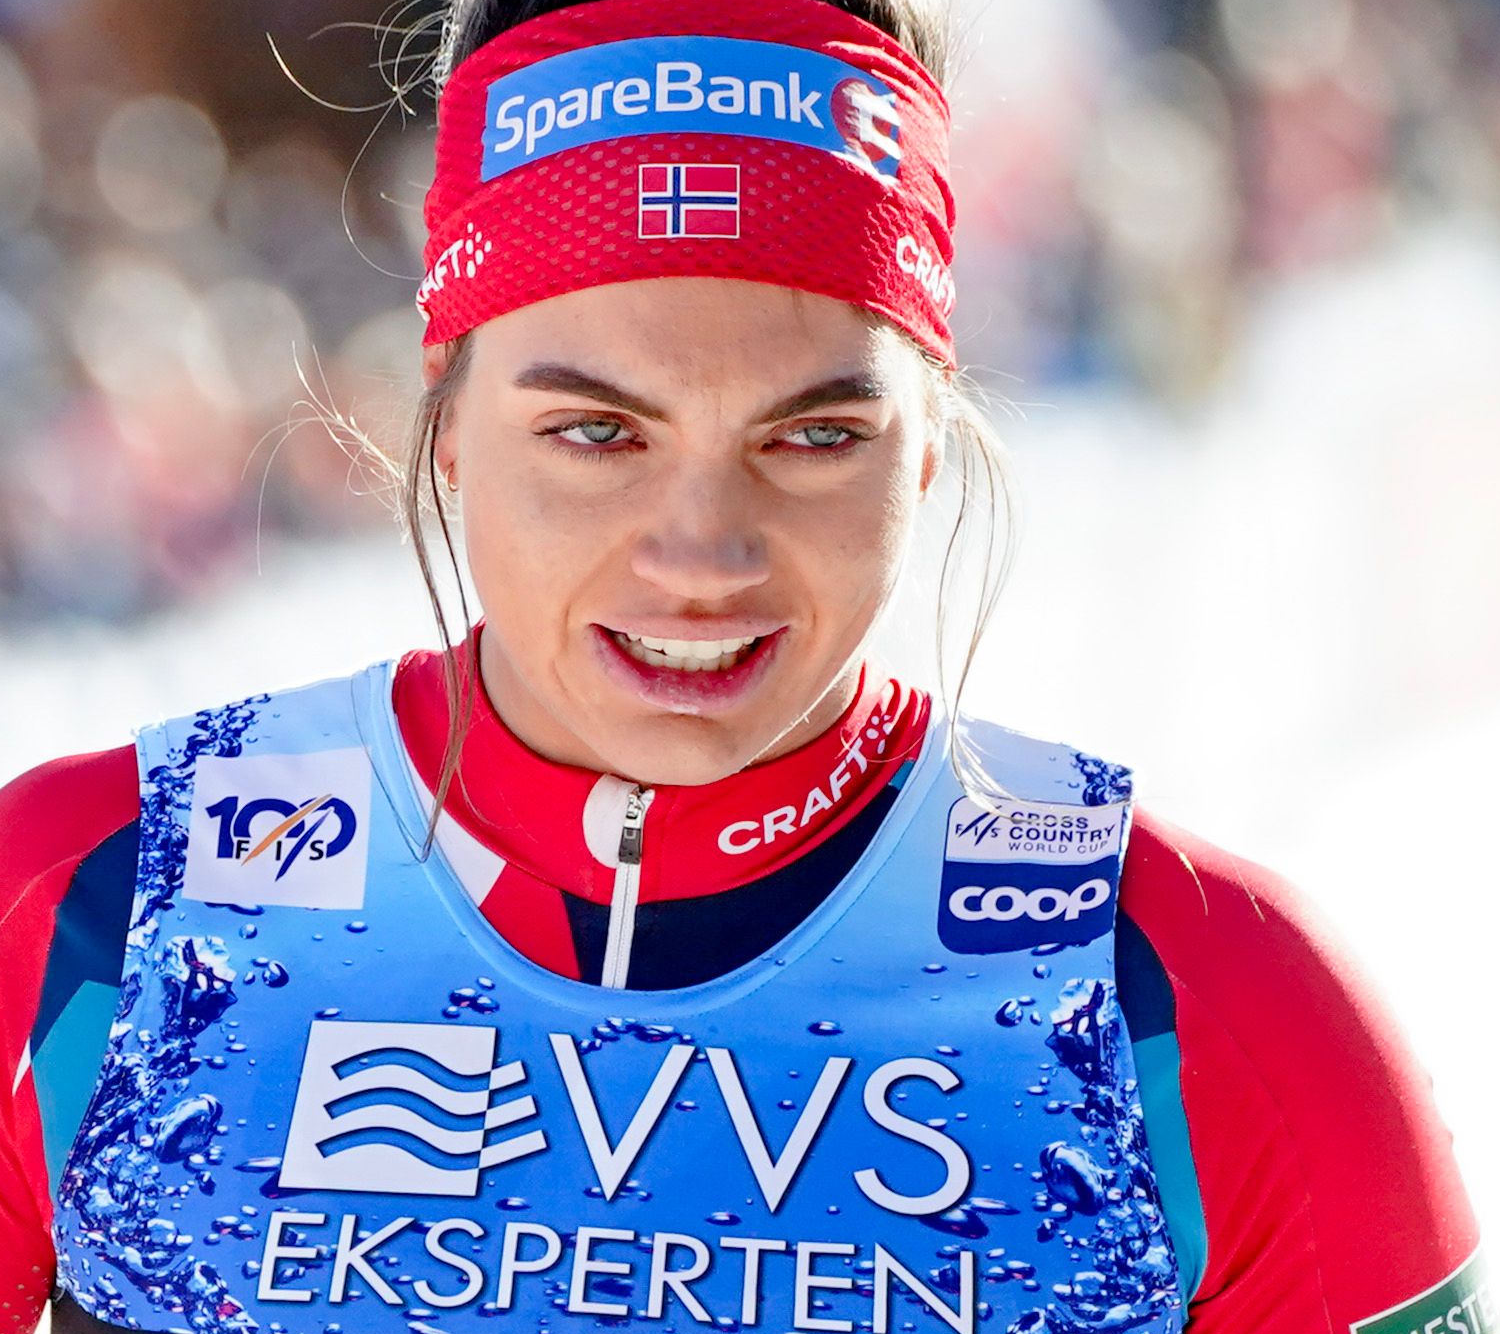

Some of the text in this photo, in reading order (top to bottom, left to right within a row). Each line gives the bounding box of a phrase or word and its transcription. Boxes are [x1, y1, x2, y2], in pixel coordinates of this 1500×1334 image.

[494, 62, 824, 155] SpareBank
[717, 737, 868, 855] CRAFT
[1010, 811, 1089, 830] CROSS
[1008, 840, 1108, 855] WORLD CUP
[1009, 824, 1116, 844] COUNTRY
[550, 1032, 973, 1215] VVS
